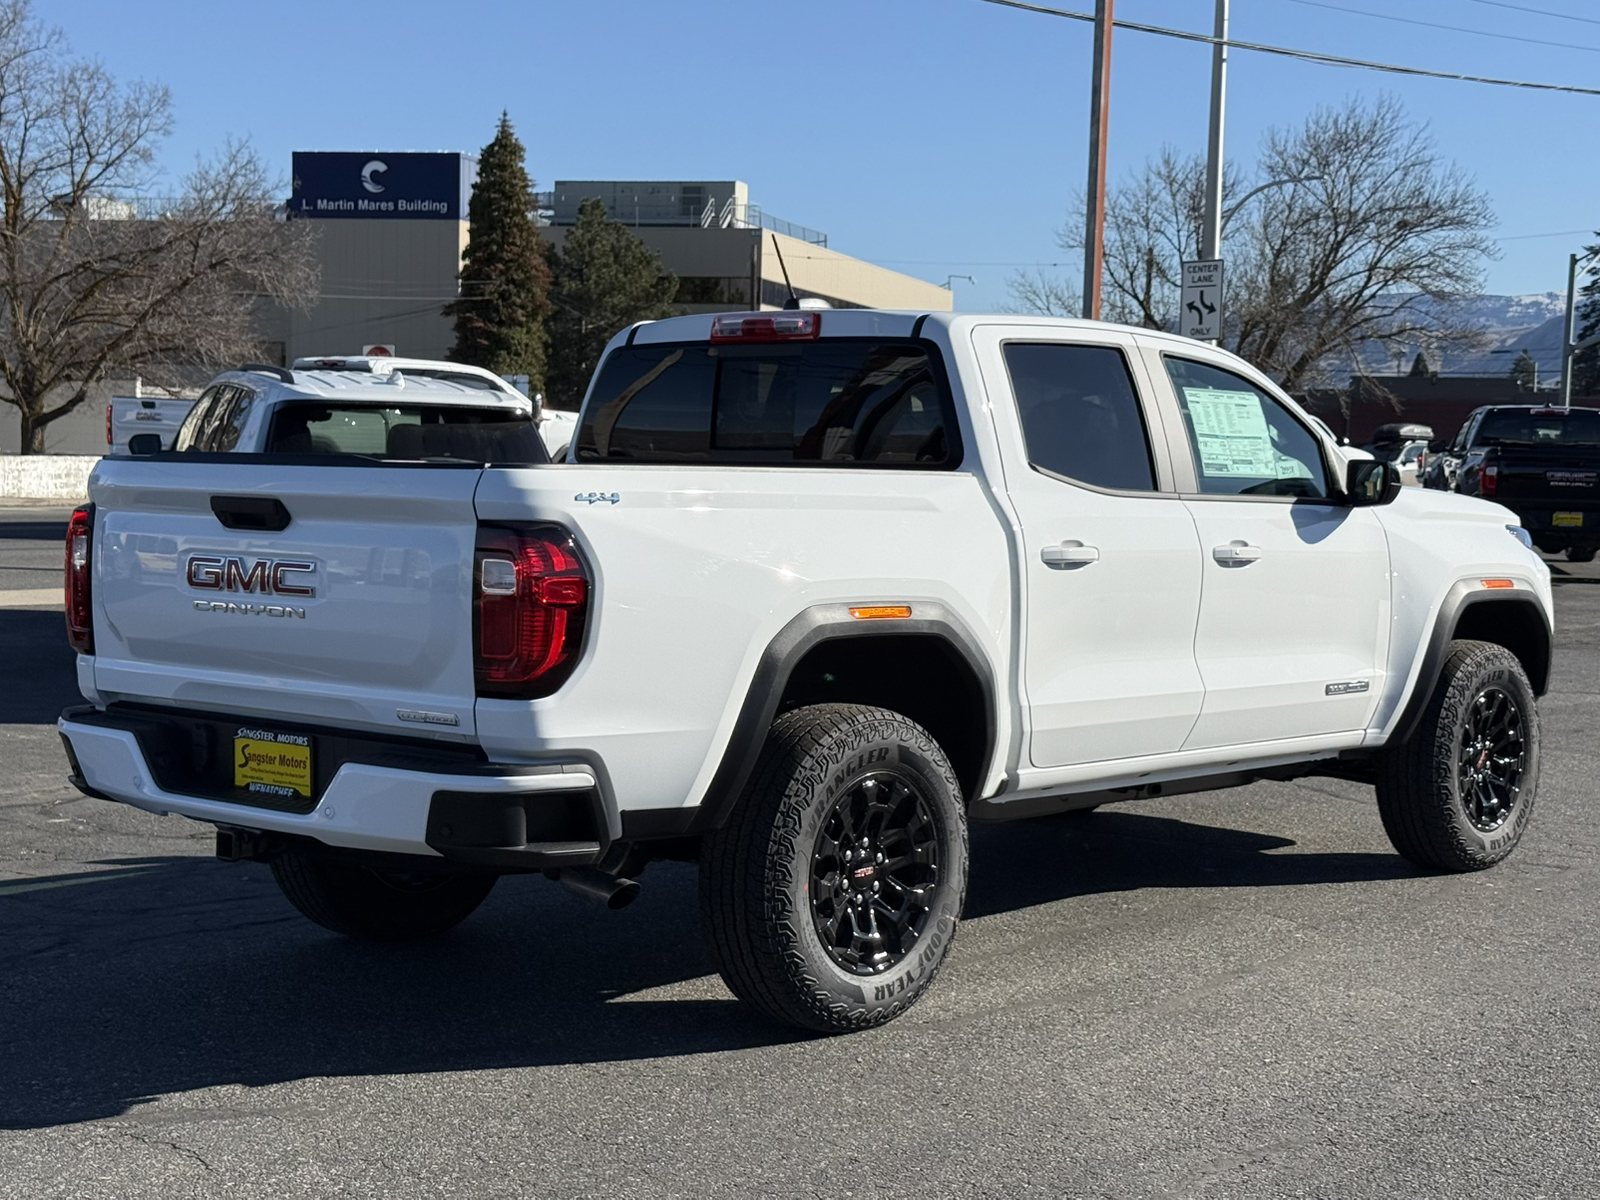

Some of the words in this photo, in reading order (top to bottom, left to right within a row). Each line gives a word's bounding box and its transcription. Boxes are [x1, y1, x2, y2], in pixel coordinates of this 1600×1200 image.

[302, 199, 313, 210] L.
[317, 199, 354, 211] Martin
[358, 199, 394, 211] Mares
[398, 199, 448, 214] Building
[1187, 264, 1218, 274] CENTER
[1191, 275, 1213, 283] LANE
[1190, 327, 1211, 336] ONLY
[186, 552, 316, 598] GMC
[193, 600, 306, 619] CANYON
[233, 727, 275, 742] SANGSTER
[277, 733, 308, 746] MOTORS
[238, 743, 277, 769] Sangster
[278, 754, 307, 770] Motors
[805, 747, 889, 839] WRANGLER
